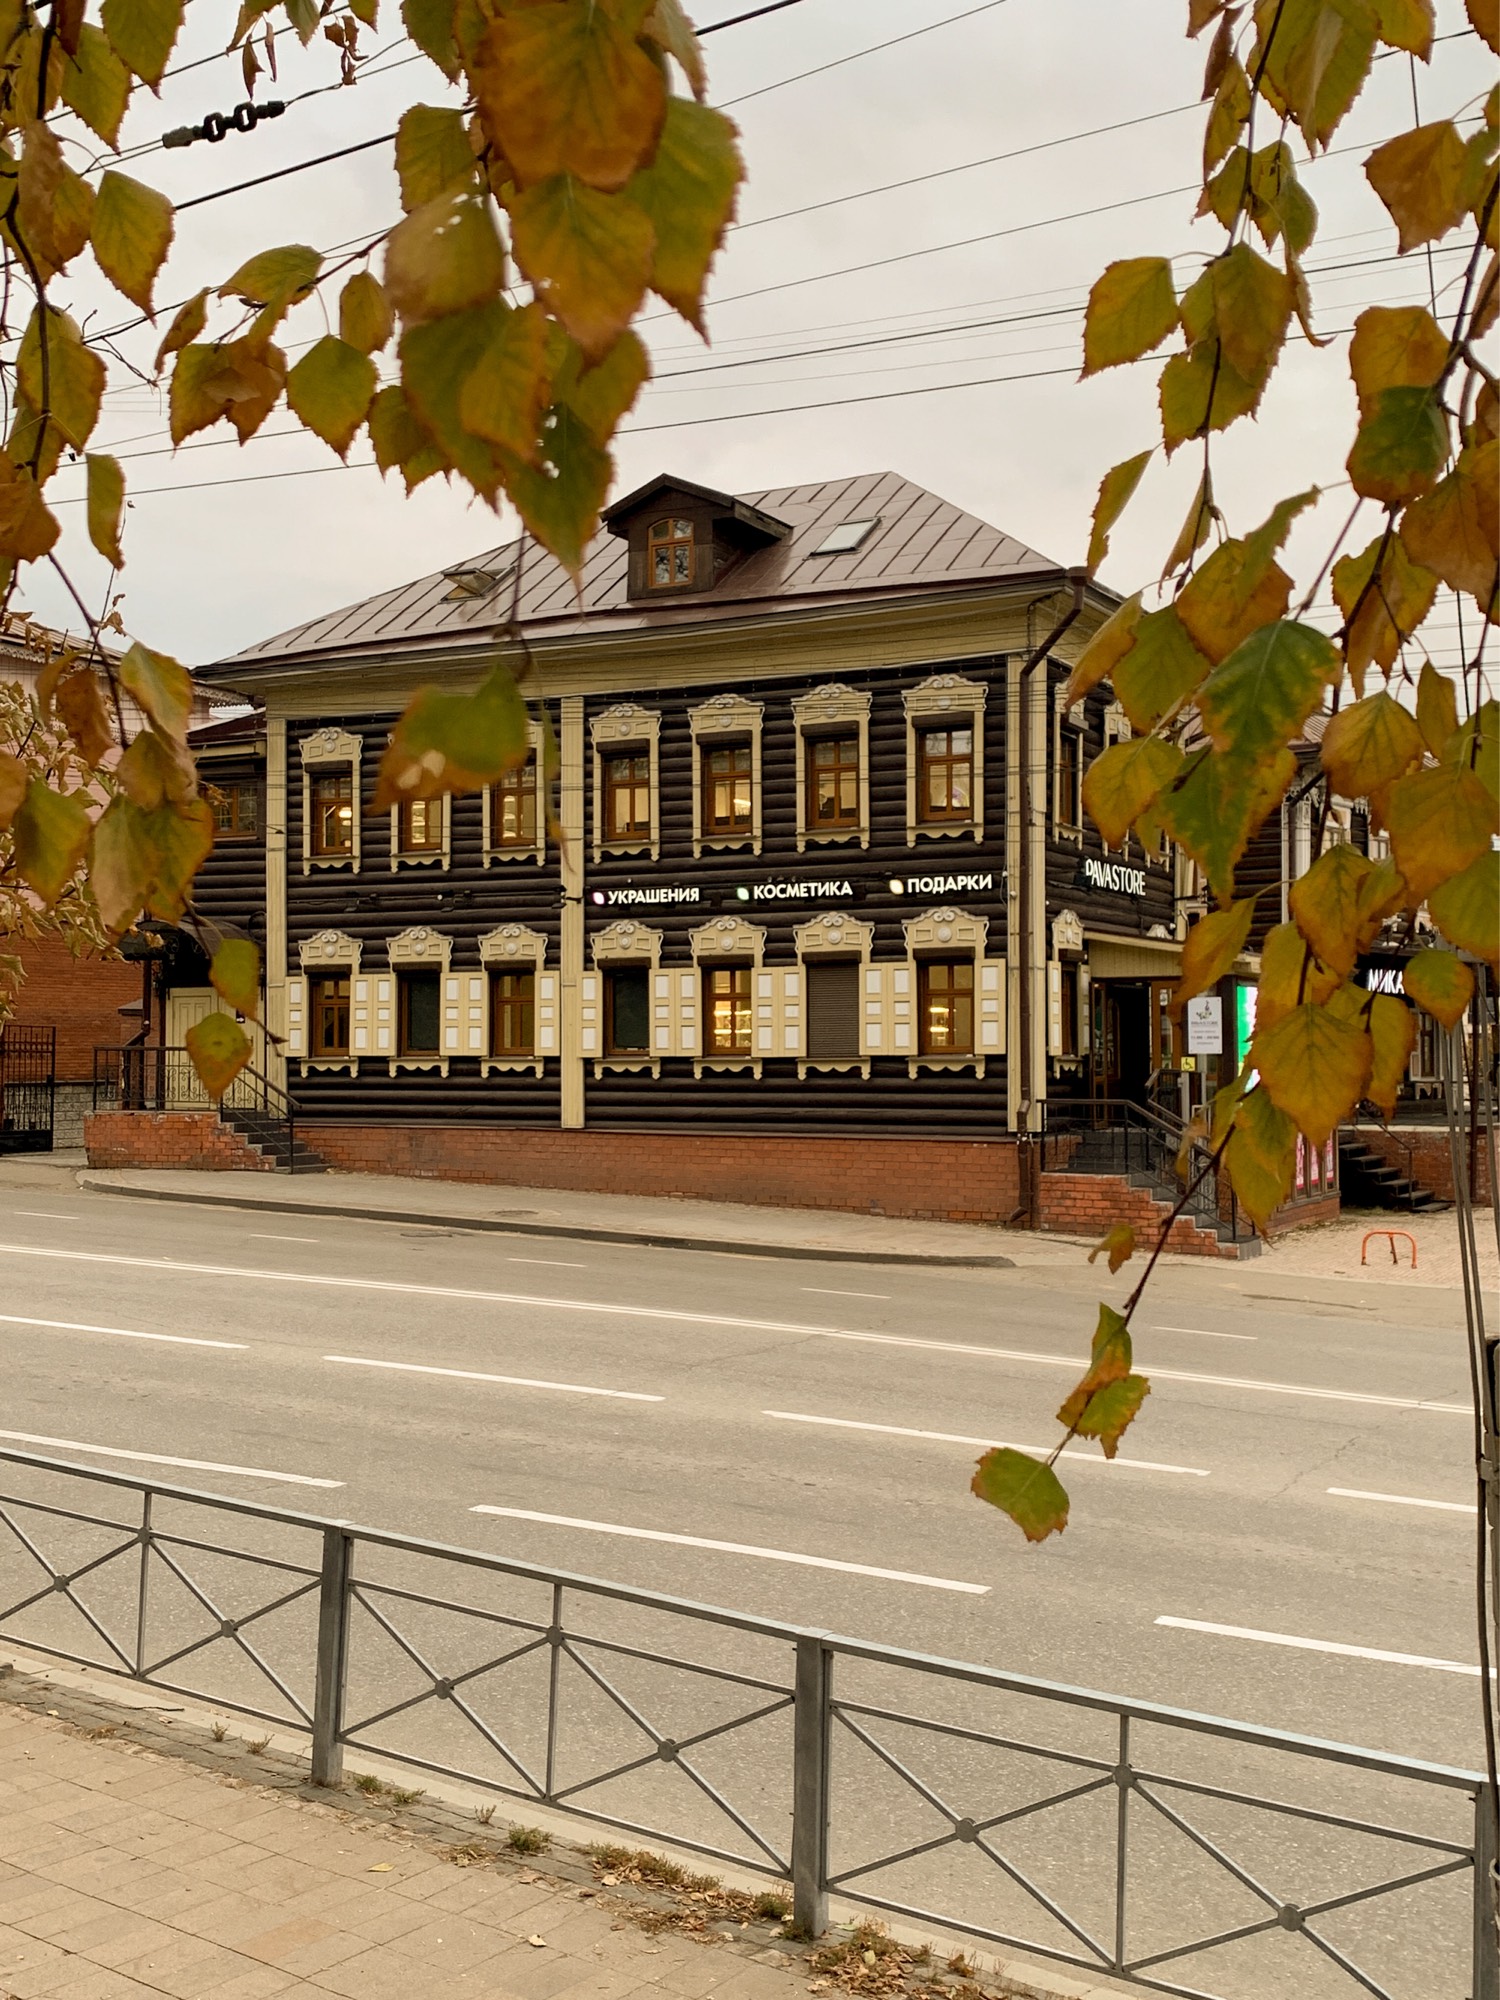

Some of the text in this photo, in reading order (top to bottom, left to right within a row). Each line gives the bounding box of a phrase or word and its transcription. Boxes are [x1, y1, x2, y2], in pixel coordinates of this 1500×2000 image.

[607, 874, 993, 905] УКРАШЕНИЯ КОСМЕТИКА ПОДАРКИ
